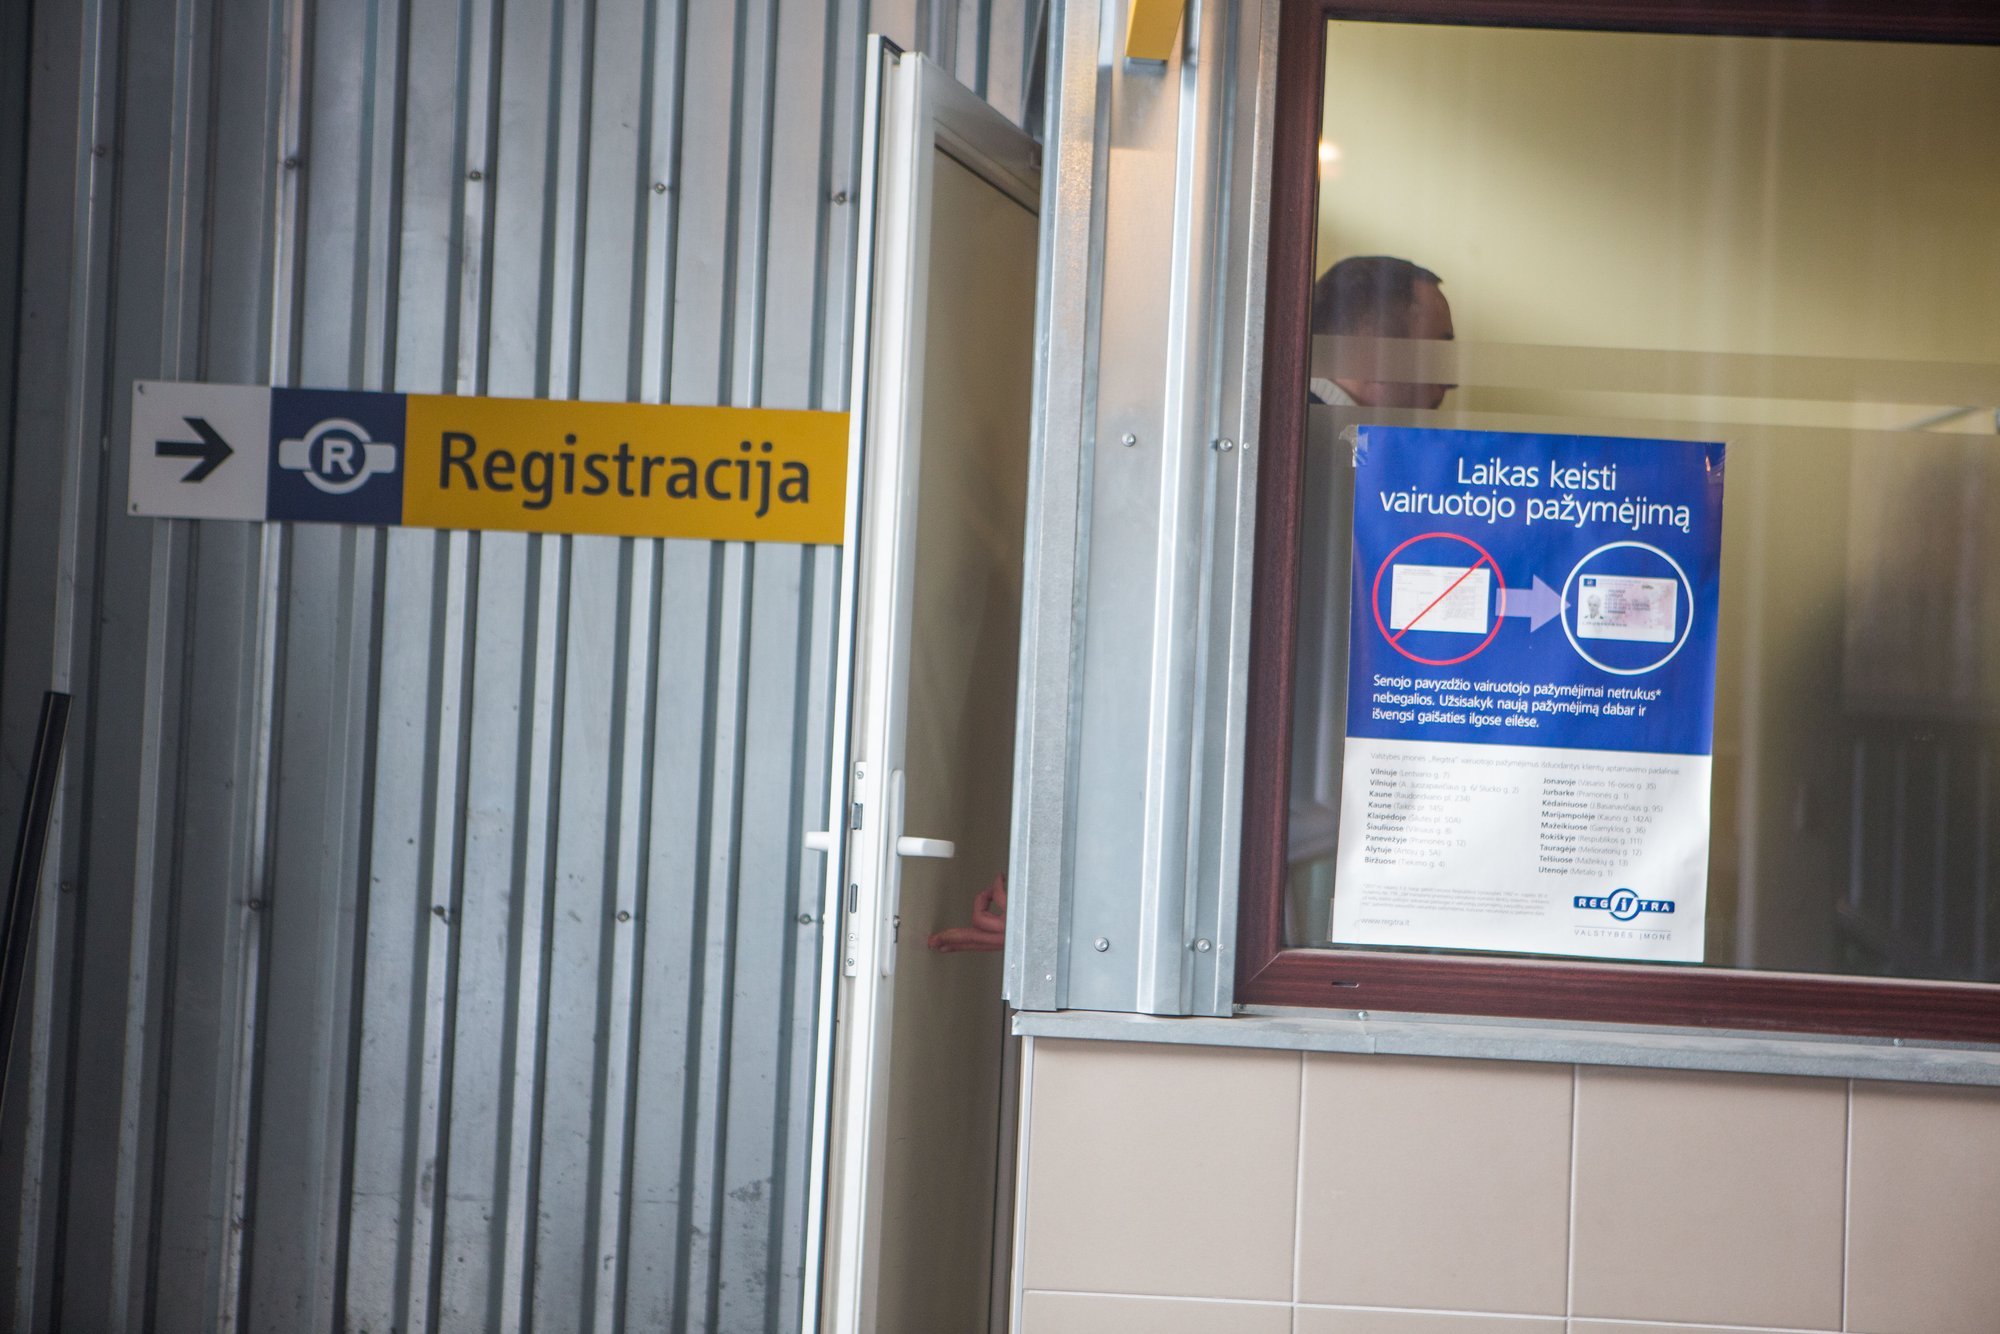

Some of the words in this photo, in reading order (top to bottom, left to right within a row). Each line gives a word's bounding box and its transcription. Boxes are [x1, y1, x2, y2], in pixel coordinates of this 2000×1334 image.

[322, 440, 354, 475] R
[439, 431, 810, 519] Registracija
[1457, 456, 1539, 487] Laikas
[1550, 460, 1617, 491] keisti
[1380, 486, 1517, 524] vairuotojo
[1526, 492, 1691, 533] pažymėjimą
[1373, 674, 1411, 690] Senojo
[1414, 677, 1470, 692] pavyzdžio
[1474, 680, 1530, 696] vairuotojo
[1533, 682, 1604, 699] pažymėjimai
[1373, 692, 1435, 707] nebegalios.
[1439, 694, 1493, 711] Užsisakyk
[1497, 697, 1528, 713] naują
[1532, 700, 1599, 717] pažymėjimą
[1602, 702, 1635, 716] dabar
[1638, 704, 1646, 717] ir
[1372, 708, 1414, 723] išvengsi
[1418, 710, 1466, 725] gaišaties
[1469, 711, 1502, 727] ilgose
[1505, 712, 1539, 728] eilėse.
[1370, 768, 1397, 777] Vilniuje
[1370, 780, 1397, 789] Vilniuje
[1543, 777, 1576, 787] Jonavoje
[1542, 788, 1575, 797] Jurbarke
[1368, 801, 1392, 809] Kaune
[1542, 799, 1588, 809] Kėdainiuose
[1367, 811, 1406, 822] Klaipėdoje
[1541, 810, 1596, 821] Marijampolėje
[1366, 822, 1404, 832] Šiauliuose
[1541, 822, 1588, 831] Mažeikiuose
[1365, 834, 1407, 844] Panevėžyje
[1540, 833, 1576, 843] Rokiškyje
[1365, 846, 1392, 855] Alytuje
[1540, 844, 1576, 854] Tauragėje
[1364, 856, 1396, 865] Biržuose
[1539, 855, 1573, 864] Telšiuose
[1538, 866, 1568, 876] Utenoje
